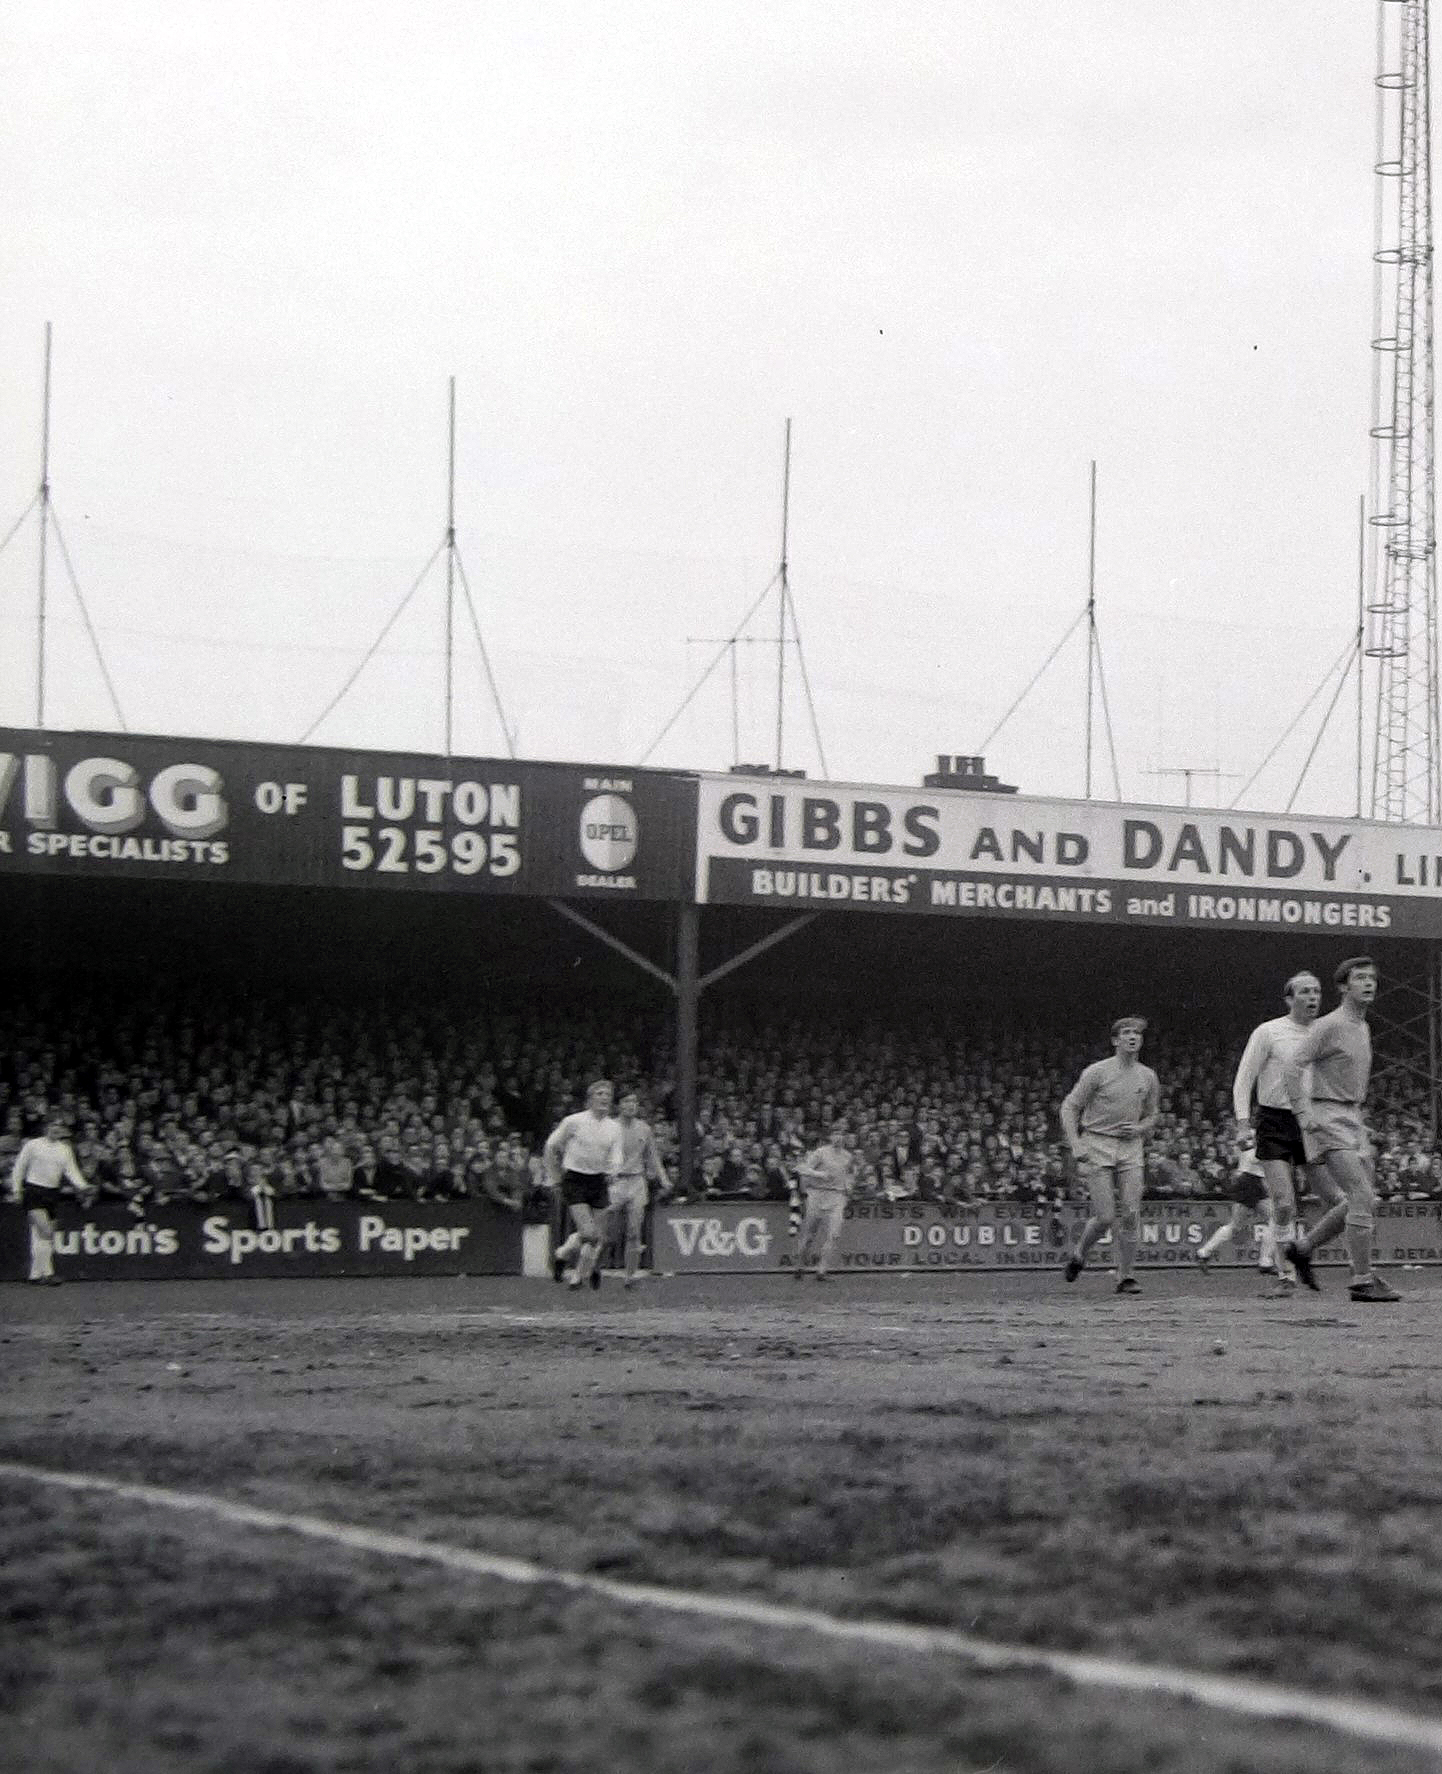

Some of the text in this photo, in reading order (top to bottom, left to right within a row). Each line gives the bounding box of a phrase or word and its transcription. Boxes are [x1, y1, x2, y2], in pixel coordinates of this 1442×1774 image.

[254, 782, 307, 815] OF
[341, 774, 520, 828] LUTON
[27, 831, 230, 865] SPECIALISTS
[586, 823, 632, 842] OPEL
[717, 792, 941, 857] GIBBS
[969, 827, 1090, 866] AND
[341, 825, 521, 876] 52595
[930, 880, 1112, 914] MERCHANTS
[1127, 893, 1175, 918] and
[1187, 894, 1392, 929] IRONMONGERS
[54, 1215, 470, 1265] uton's Sports Paper
[668, 1216, 776, 1256] V&G
[903, 1224, 1042, 1247] DOUBLE
[841, 1252, 901, 1267] YOUR
[995, 1250, 1112, 1265] INSURACE
